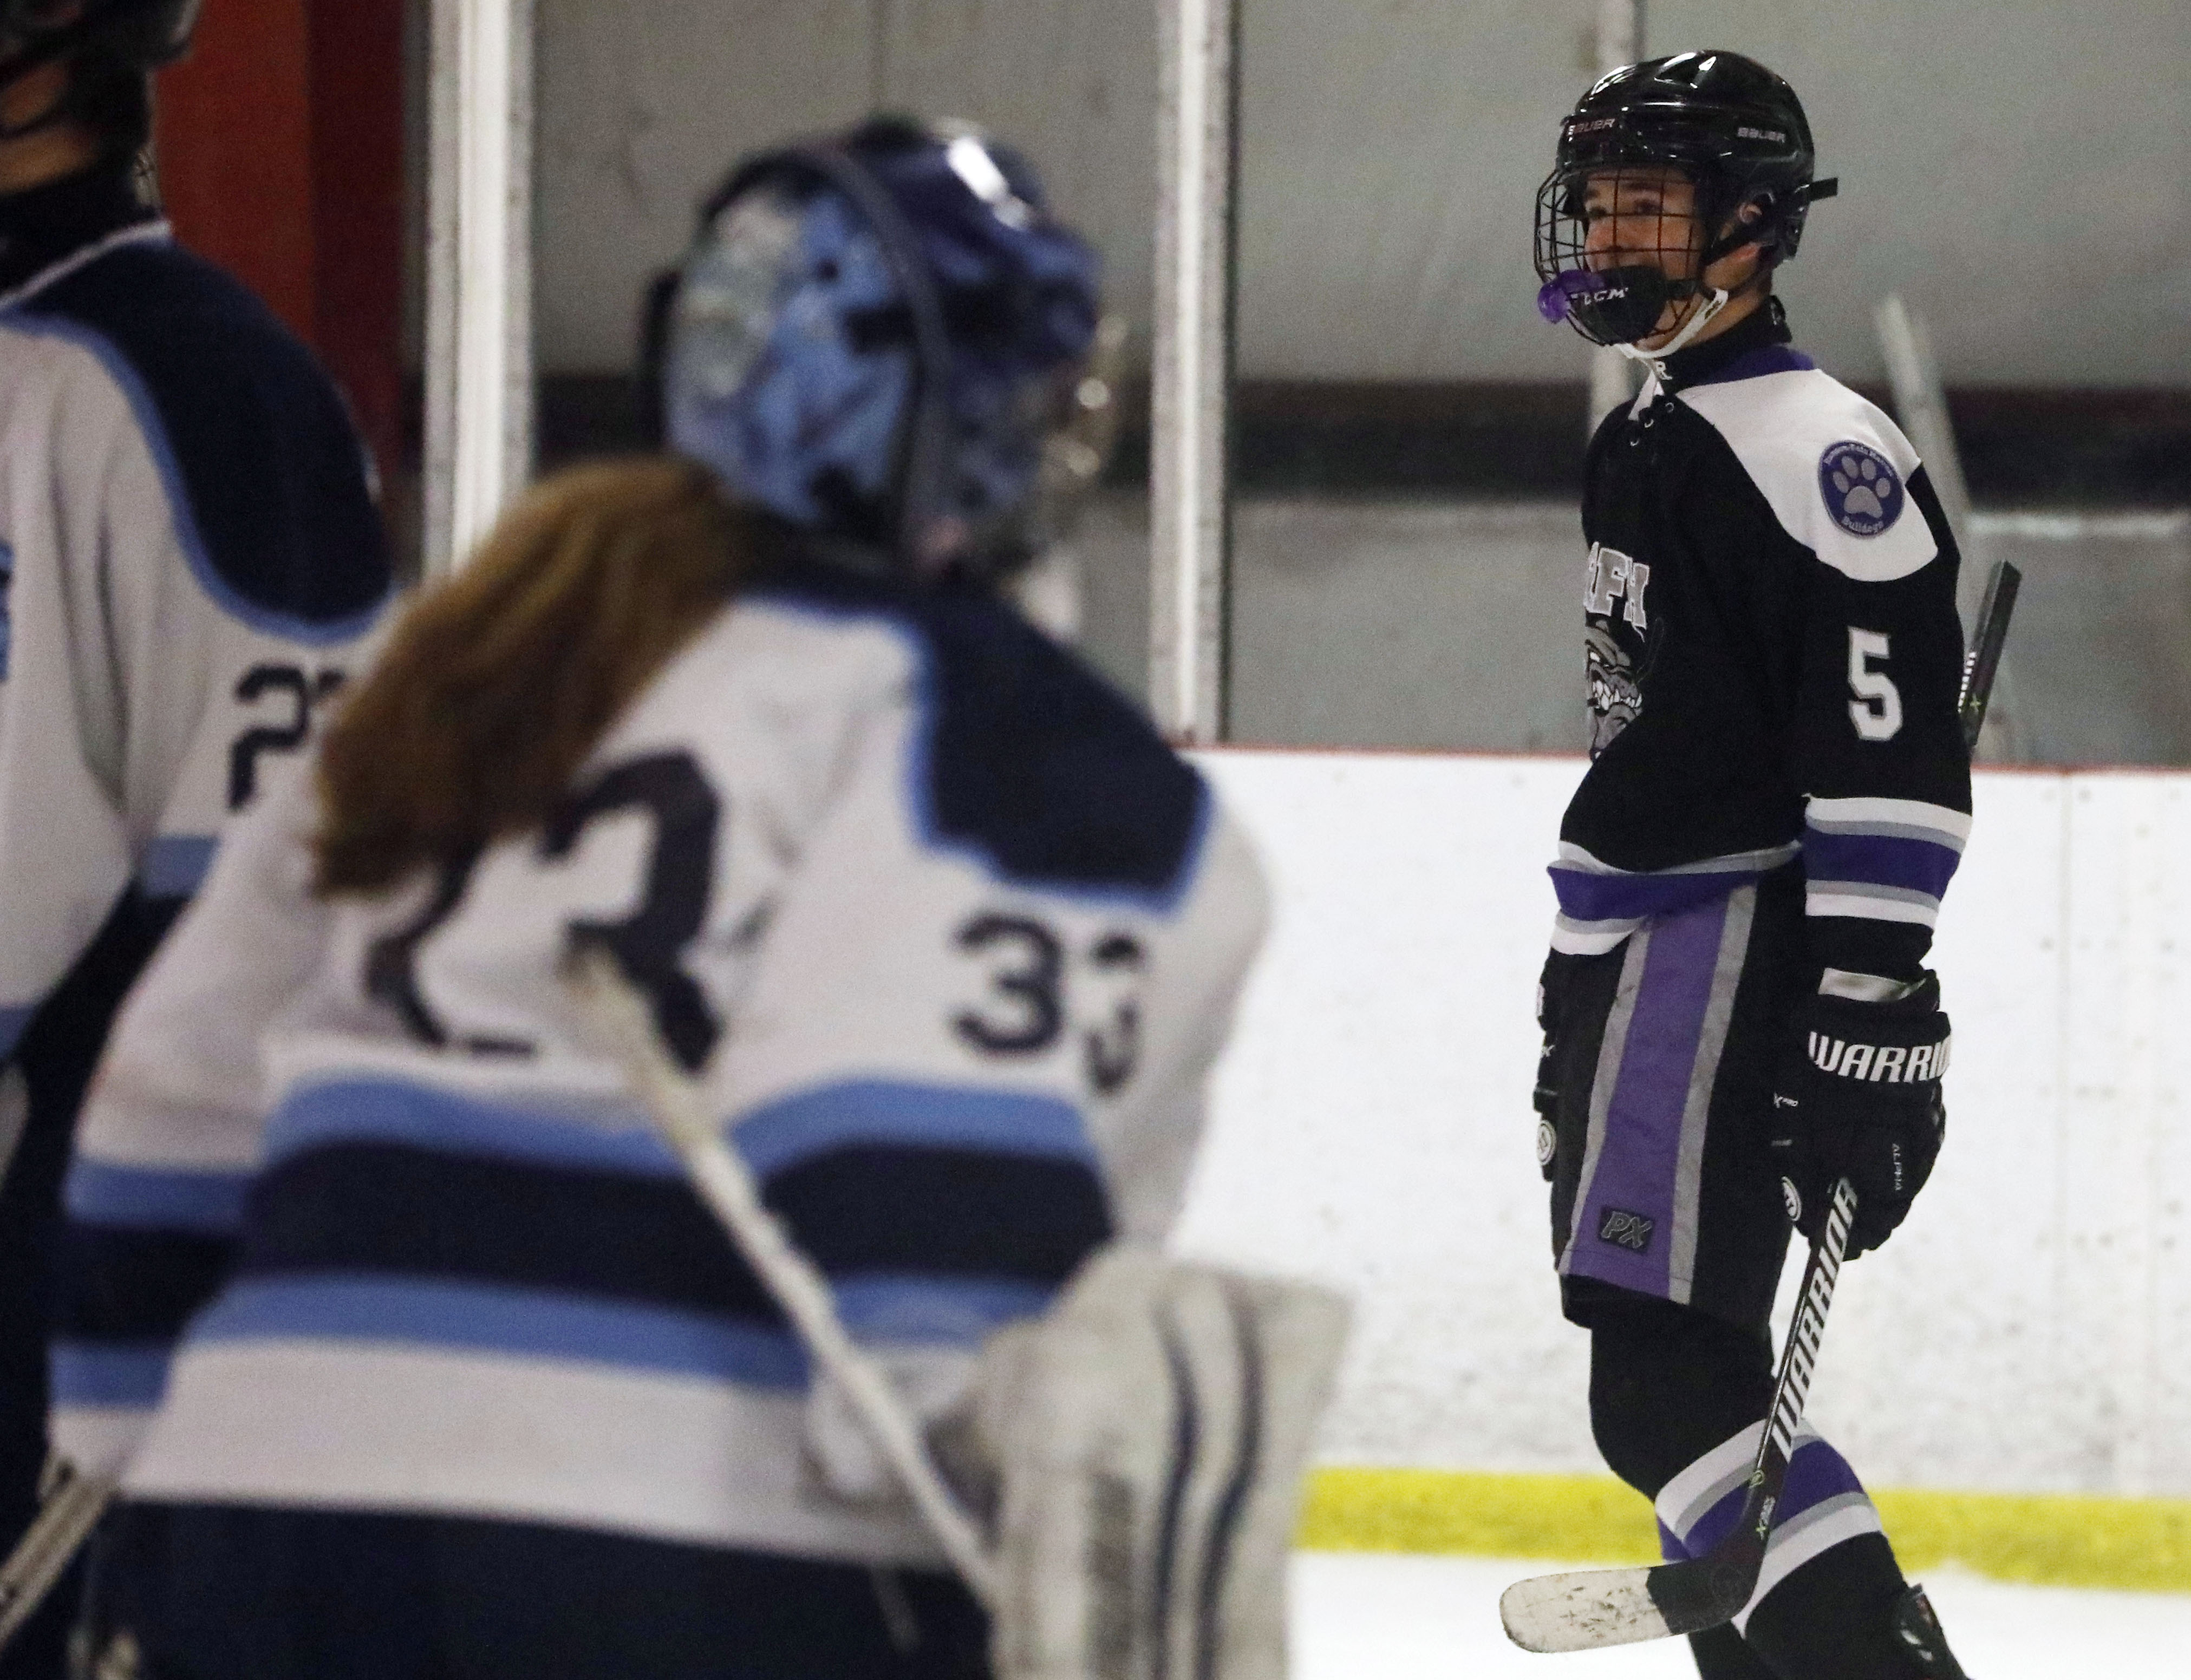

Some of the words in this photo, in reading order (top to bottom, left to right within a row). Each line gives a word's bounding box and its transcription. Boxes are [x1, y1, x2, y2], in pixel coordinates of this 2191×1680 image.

[1847, 625, 1903, 741] 5
[1601, 1211, 1652, 1248] PX
[1771, 1175, 1857, 1465] WARRIOR
